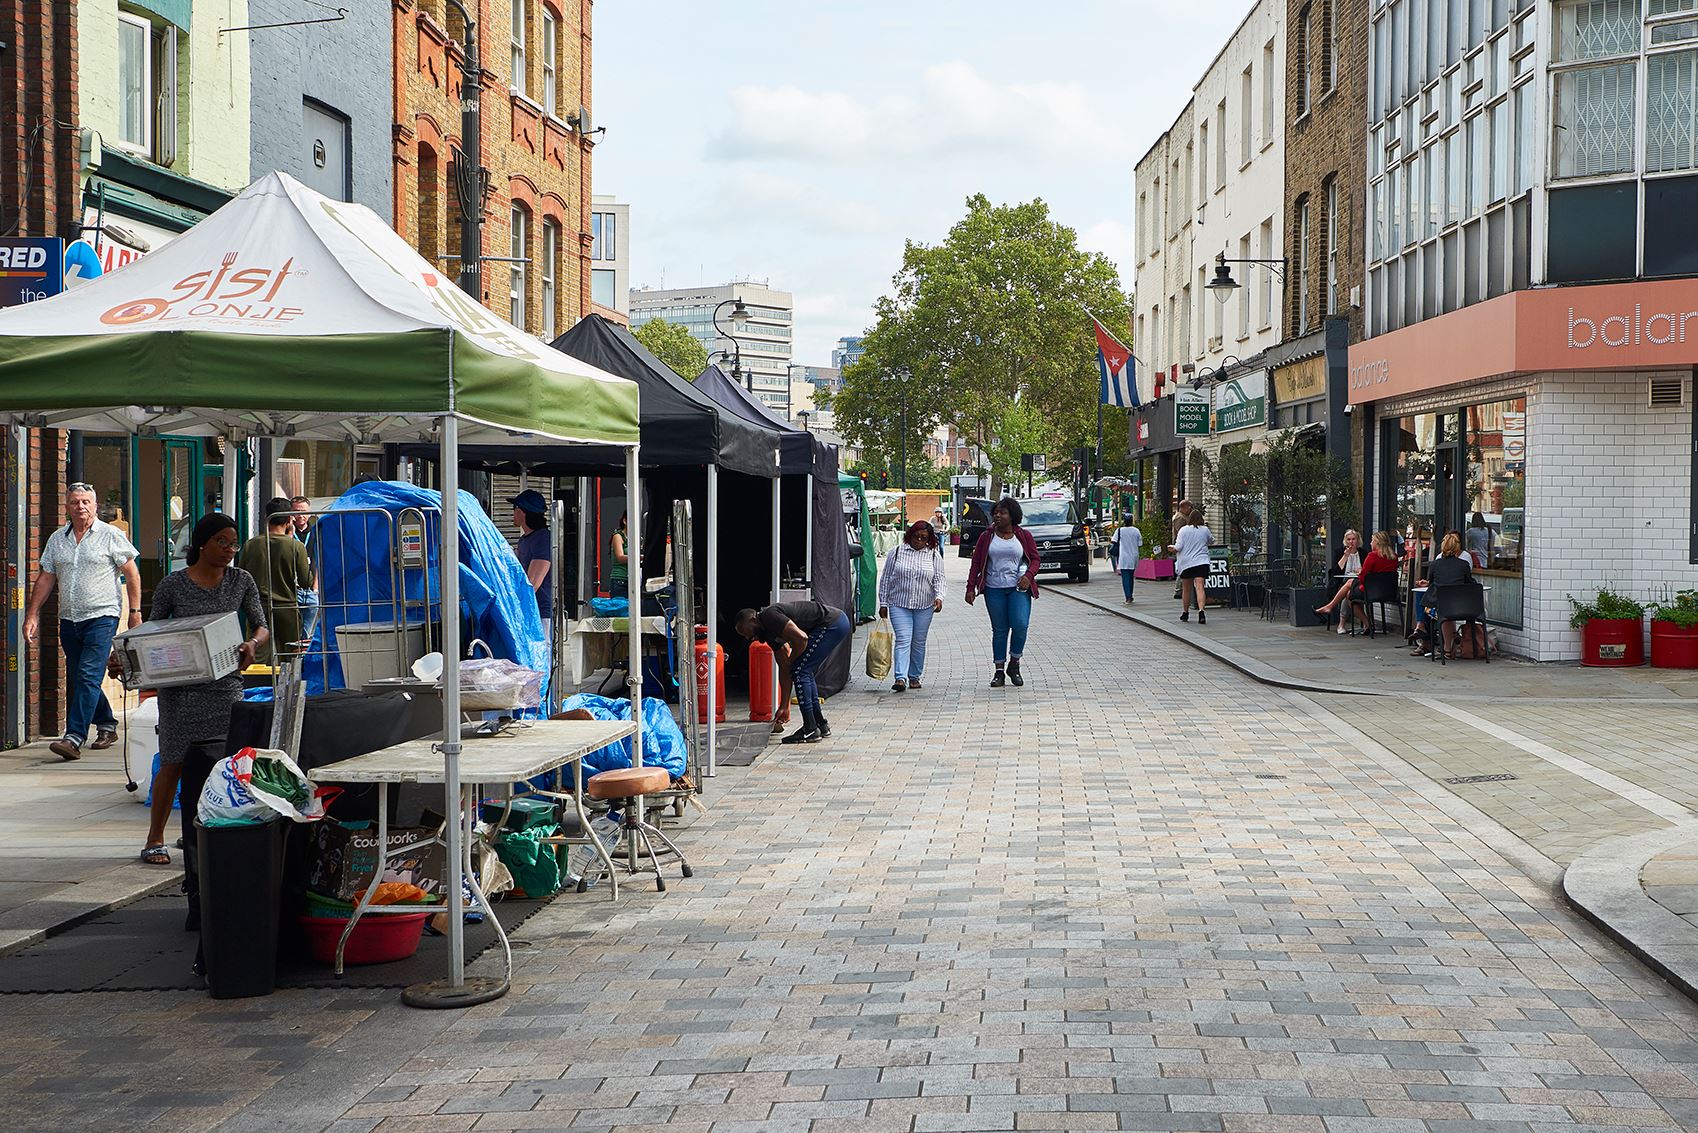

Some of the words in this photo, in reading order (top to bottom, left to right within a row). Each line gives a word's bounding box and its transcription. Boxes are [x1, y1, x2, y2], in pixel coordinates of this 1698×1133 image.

[20, 288, 47, 304] the
[1350, 355, 1390, 391] balance
[1179, 422, 1198, 430] SHOP
[1210, 560, 1228, 573] ER
[1204, 575, 1230, 588] RDEN
